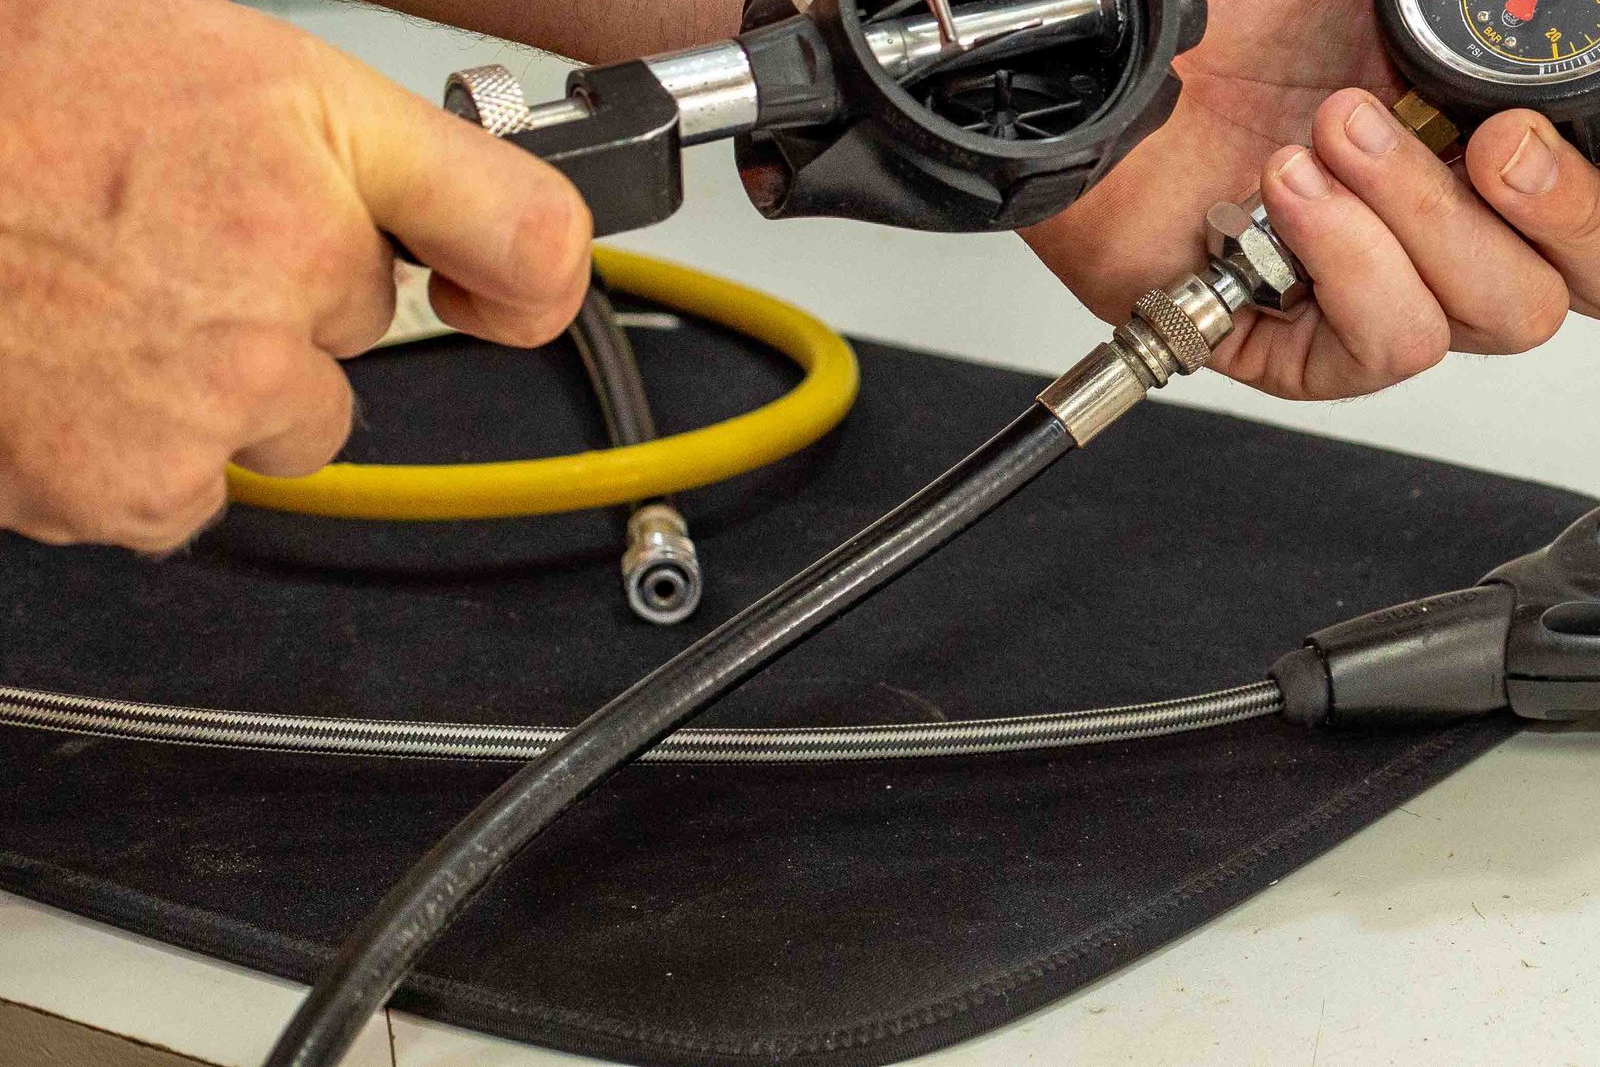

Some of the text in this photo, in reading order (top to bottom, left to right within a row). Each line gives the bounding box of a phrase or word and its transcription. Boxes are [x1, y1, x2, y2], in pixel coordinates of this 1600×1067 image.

[1483, 26, 1503, 44] BAR
[1544, 27, 1562, 43] 20
[1467, 43, 1483, 58] PSI
